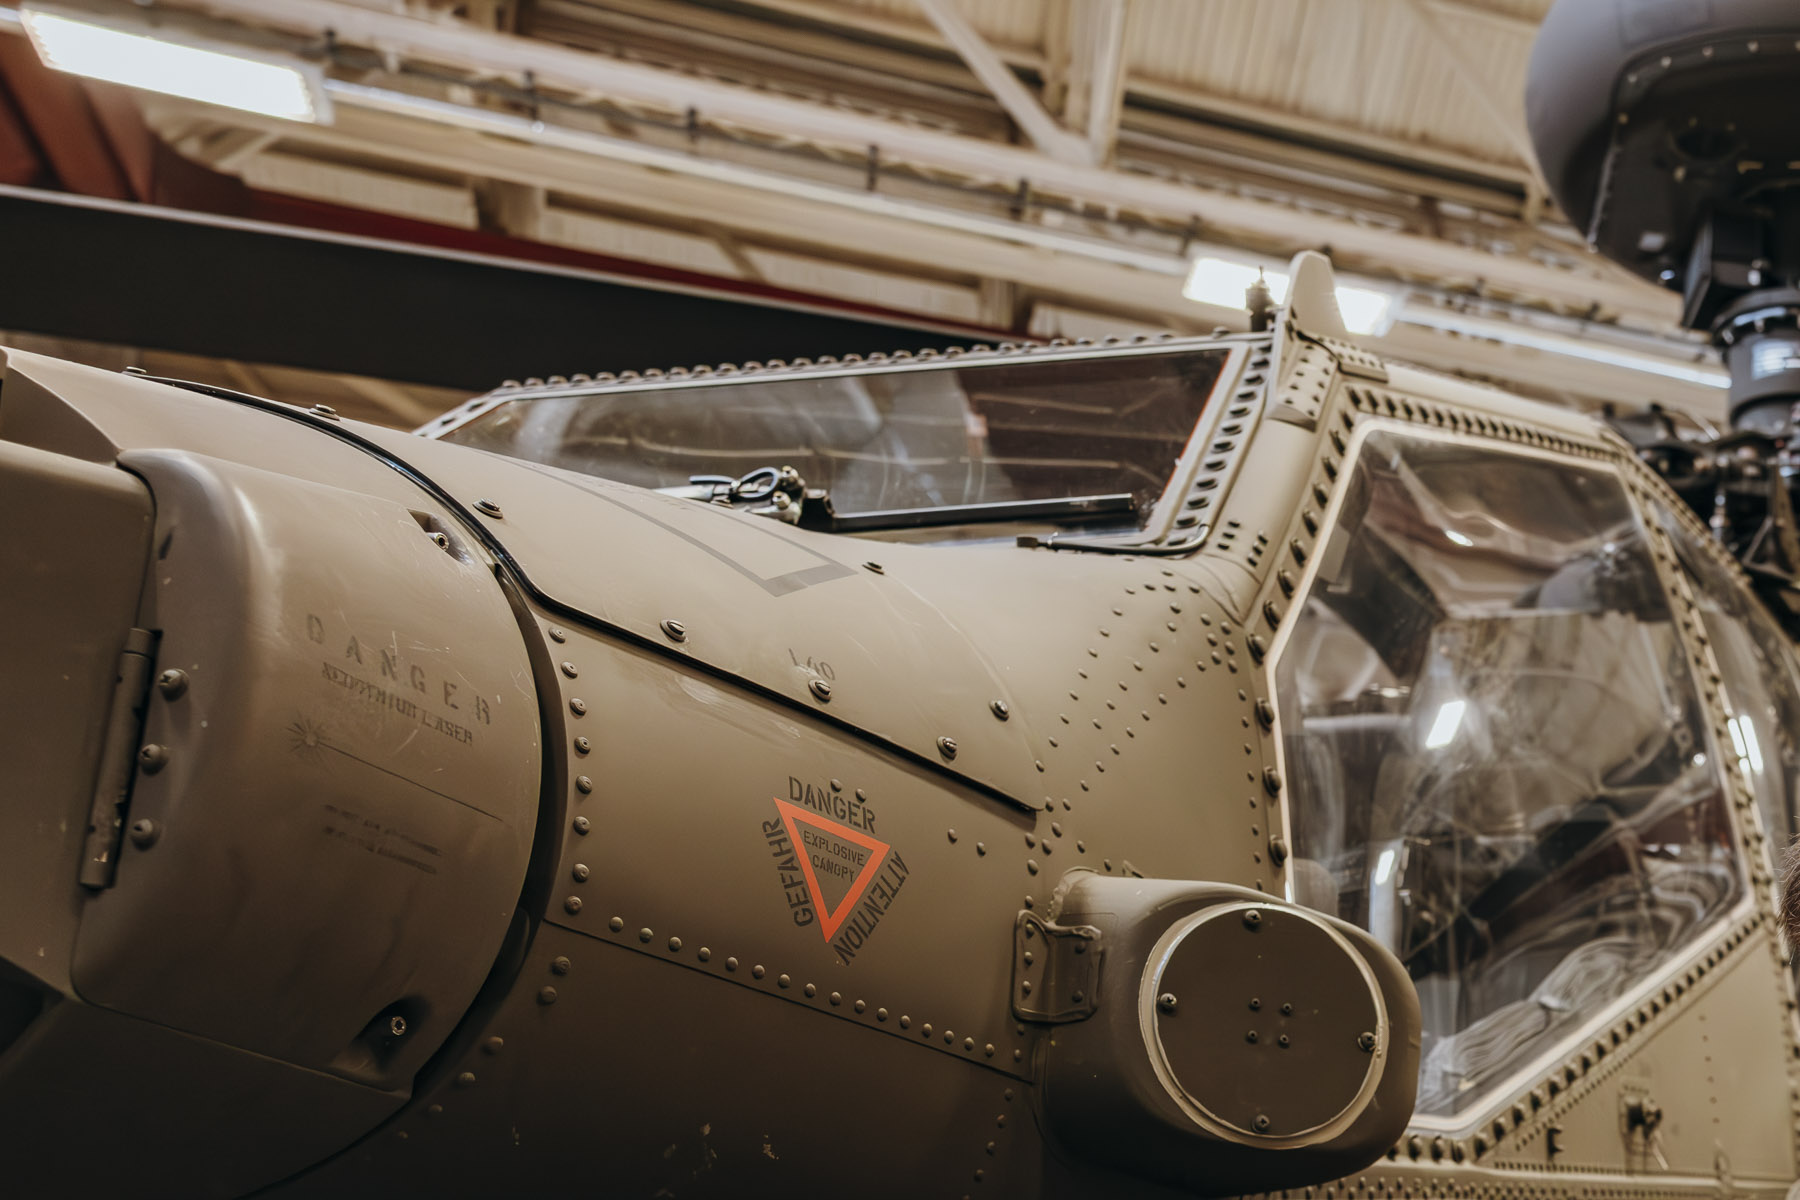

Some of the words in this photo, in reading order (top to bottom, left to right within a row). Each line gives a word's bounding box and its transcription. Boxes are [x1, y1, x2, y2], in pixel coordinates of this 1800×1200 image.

[308, 613, 490, 724] DANGER
[422, 710, 473, 744] LASER
[788, 775, 876, 834] DANGER
[762, 817, 814, 928] GEFAHR
[803, 830, 866, 867] EXPLOSIVE
[812, 854, 855, 882] CANOPY
[833, 851, 910, 966] ATTENTION
